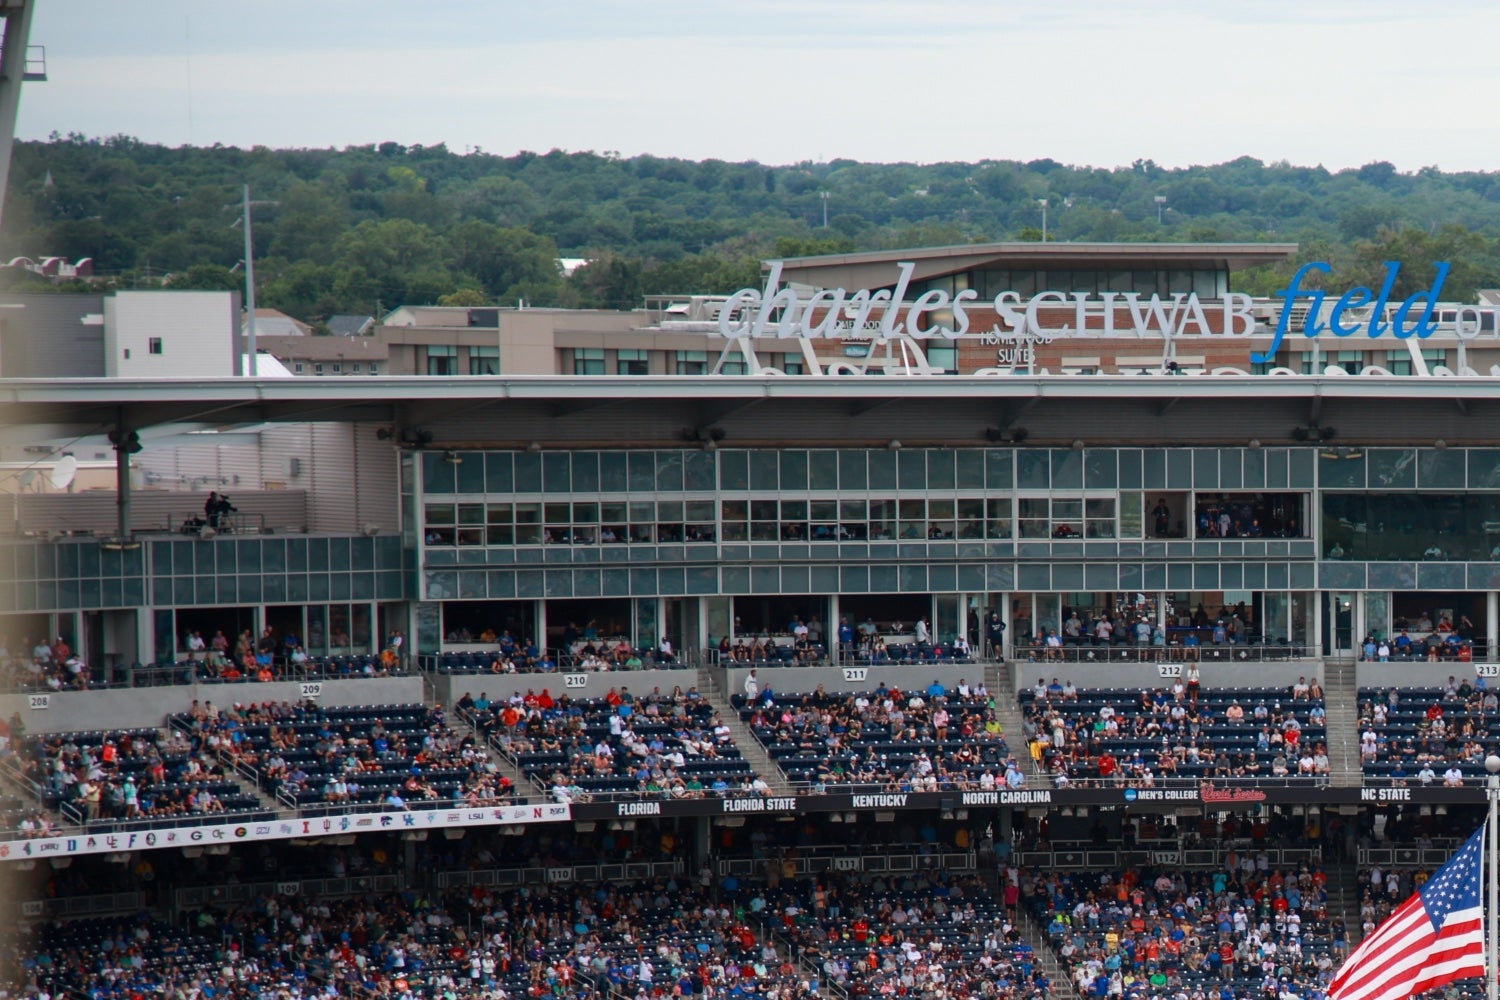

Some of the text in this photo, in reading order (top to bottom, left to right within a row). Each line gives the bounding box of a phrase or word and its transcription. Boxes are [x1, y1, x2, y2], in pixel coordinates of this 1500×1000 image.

[718, 262, 978, 340] charles
[993, 290, 1256, 340] SCHWAB
[1250, 261, 1451, 363] field
[846, 670, 865, 679] 211
[1161, 666, 1180, 675] 212
[1479, 665, 1498, 675] 213
[567, 676, 586, 685] 210
[302, 684, 320, 695] 209
[31, 697, 48, 707] 208
[962, 790, 1051, 805] NORTH CAROLINA
[1138, 790, 1164, 800] MEN'S
[1165, 790, 1199, 800] COLLEGE
[1361, 788, 1411, 801] NC STATE
[723, 798, 796, 812] FLORIDA STATE
[853, 794, 907, 807] KENTUCKY
[618, 802, 661, 816] FLORIDA
[468, 813, 484, 821] LSU
[1158, 854, 1176, 862] 112
[552, 870, 569, 879] 110
